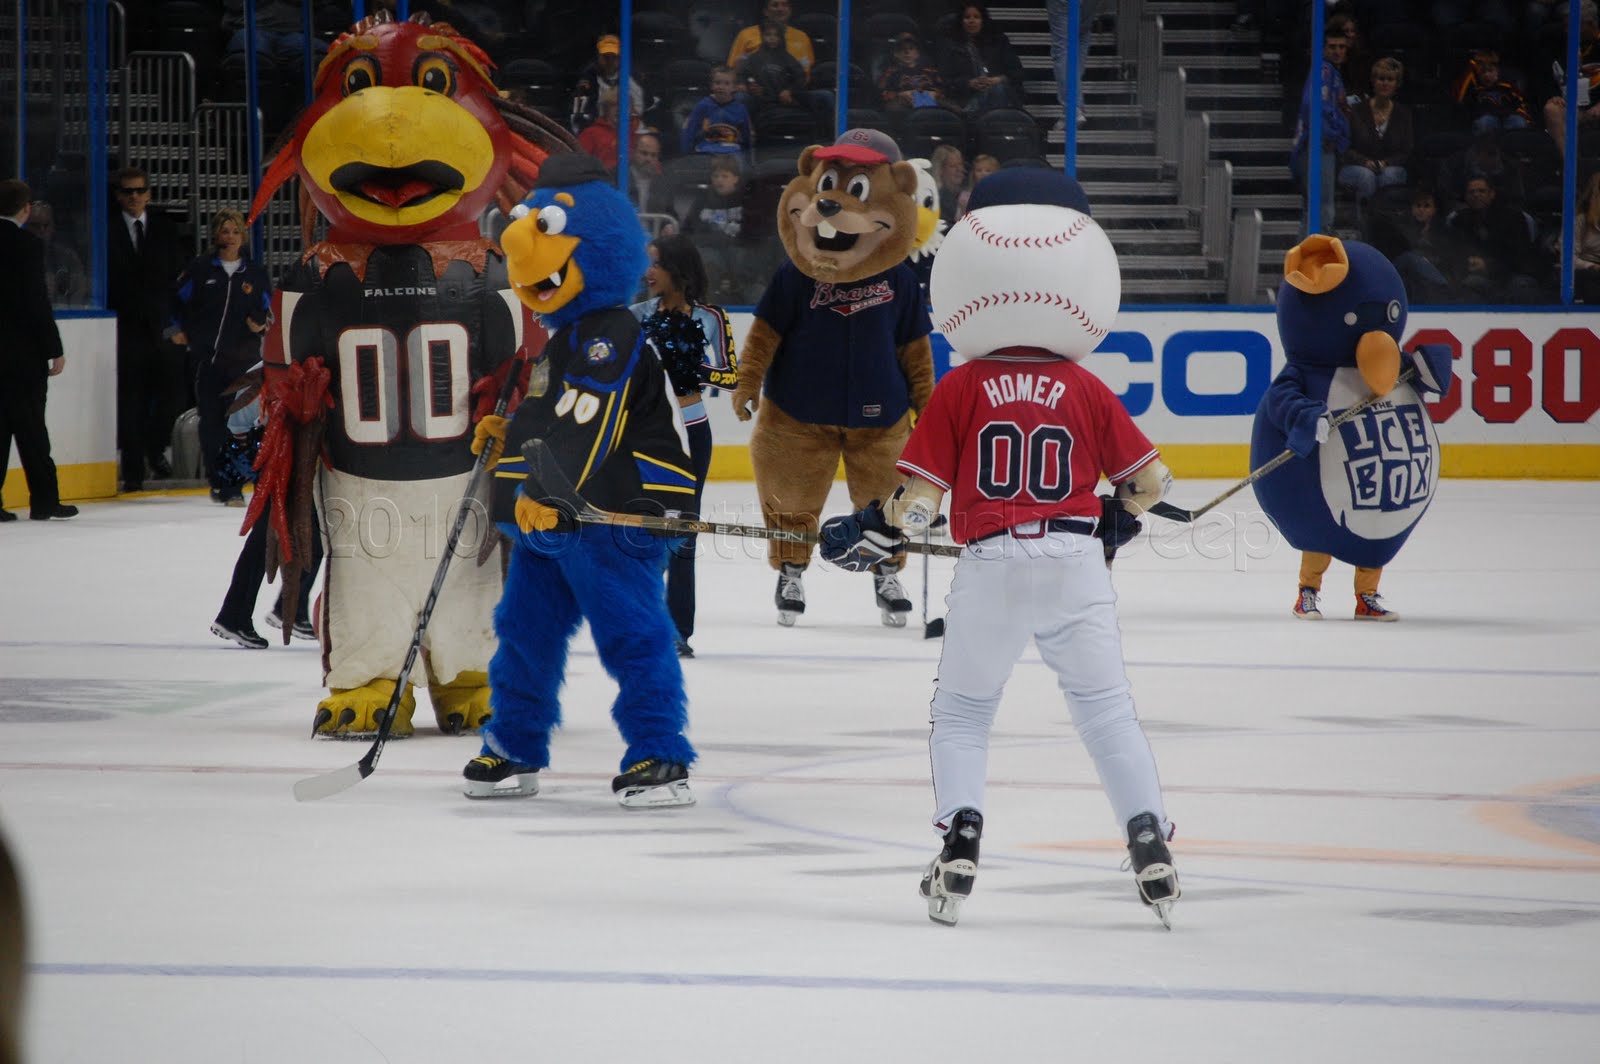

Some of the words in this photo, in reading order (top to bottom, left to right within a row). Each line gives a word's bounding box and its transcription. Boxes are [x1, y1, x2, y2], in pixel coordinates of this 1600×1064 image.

[364, 287, 437, 297] FALCONS
[338, 321, 470, 446] 00
[982, 373, 1066, 410] HOMER
[554, 388, 600, 424] 00
[1372, 400, 1393, 411] THE
[1341, 408, 1427, 456] ICE
[976, 421, 1074, 503] 00
[1350, 455, 1431, 506] BOX
[714, 525, 804, 542] EASTON
